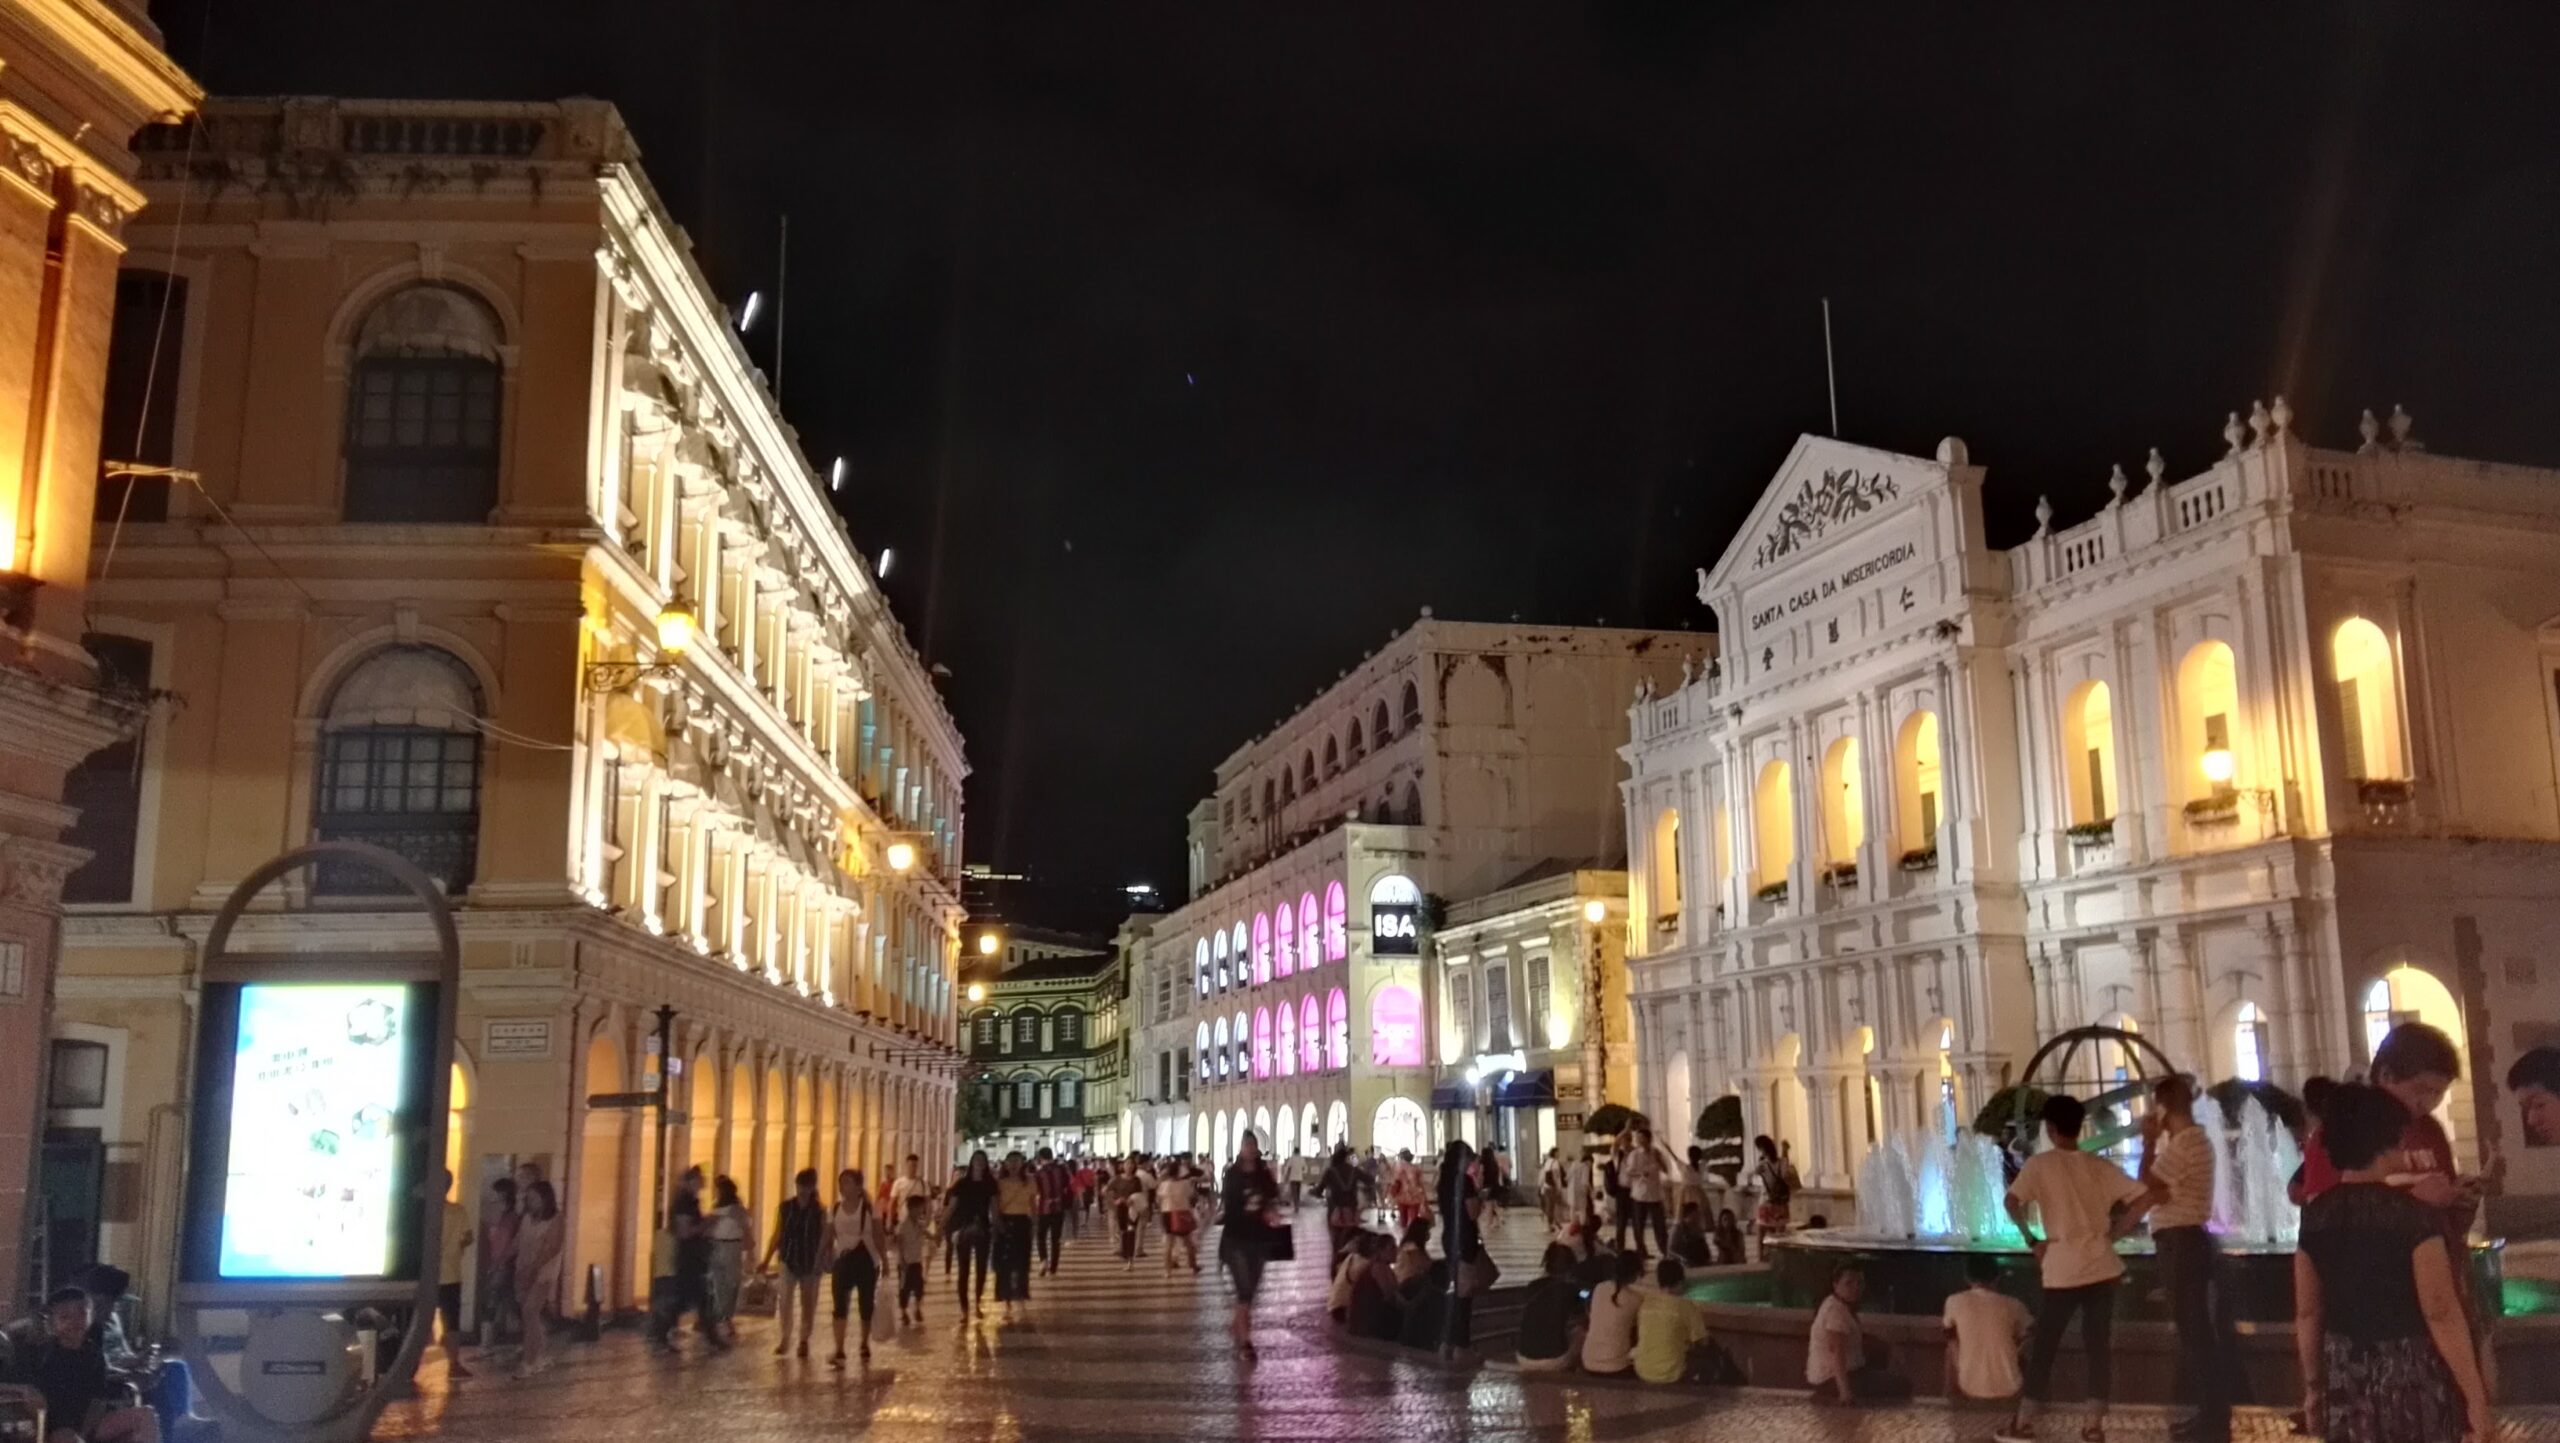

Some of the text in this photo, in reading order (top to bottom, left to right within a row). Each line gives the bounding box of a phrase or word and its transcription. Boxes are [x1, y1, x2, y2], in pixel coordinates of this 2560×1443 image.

[1752, 542, 1916, 630] SANTA CASA DA MISERICORDIA
[1374, 914, 1416, 938] ISA
